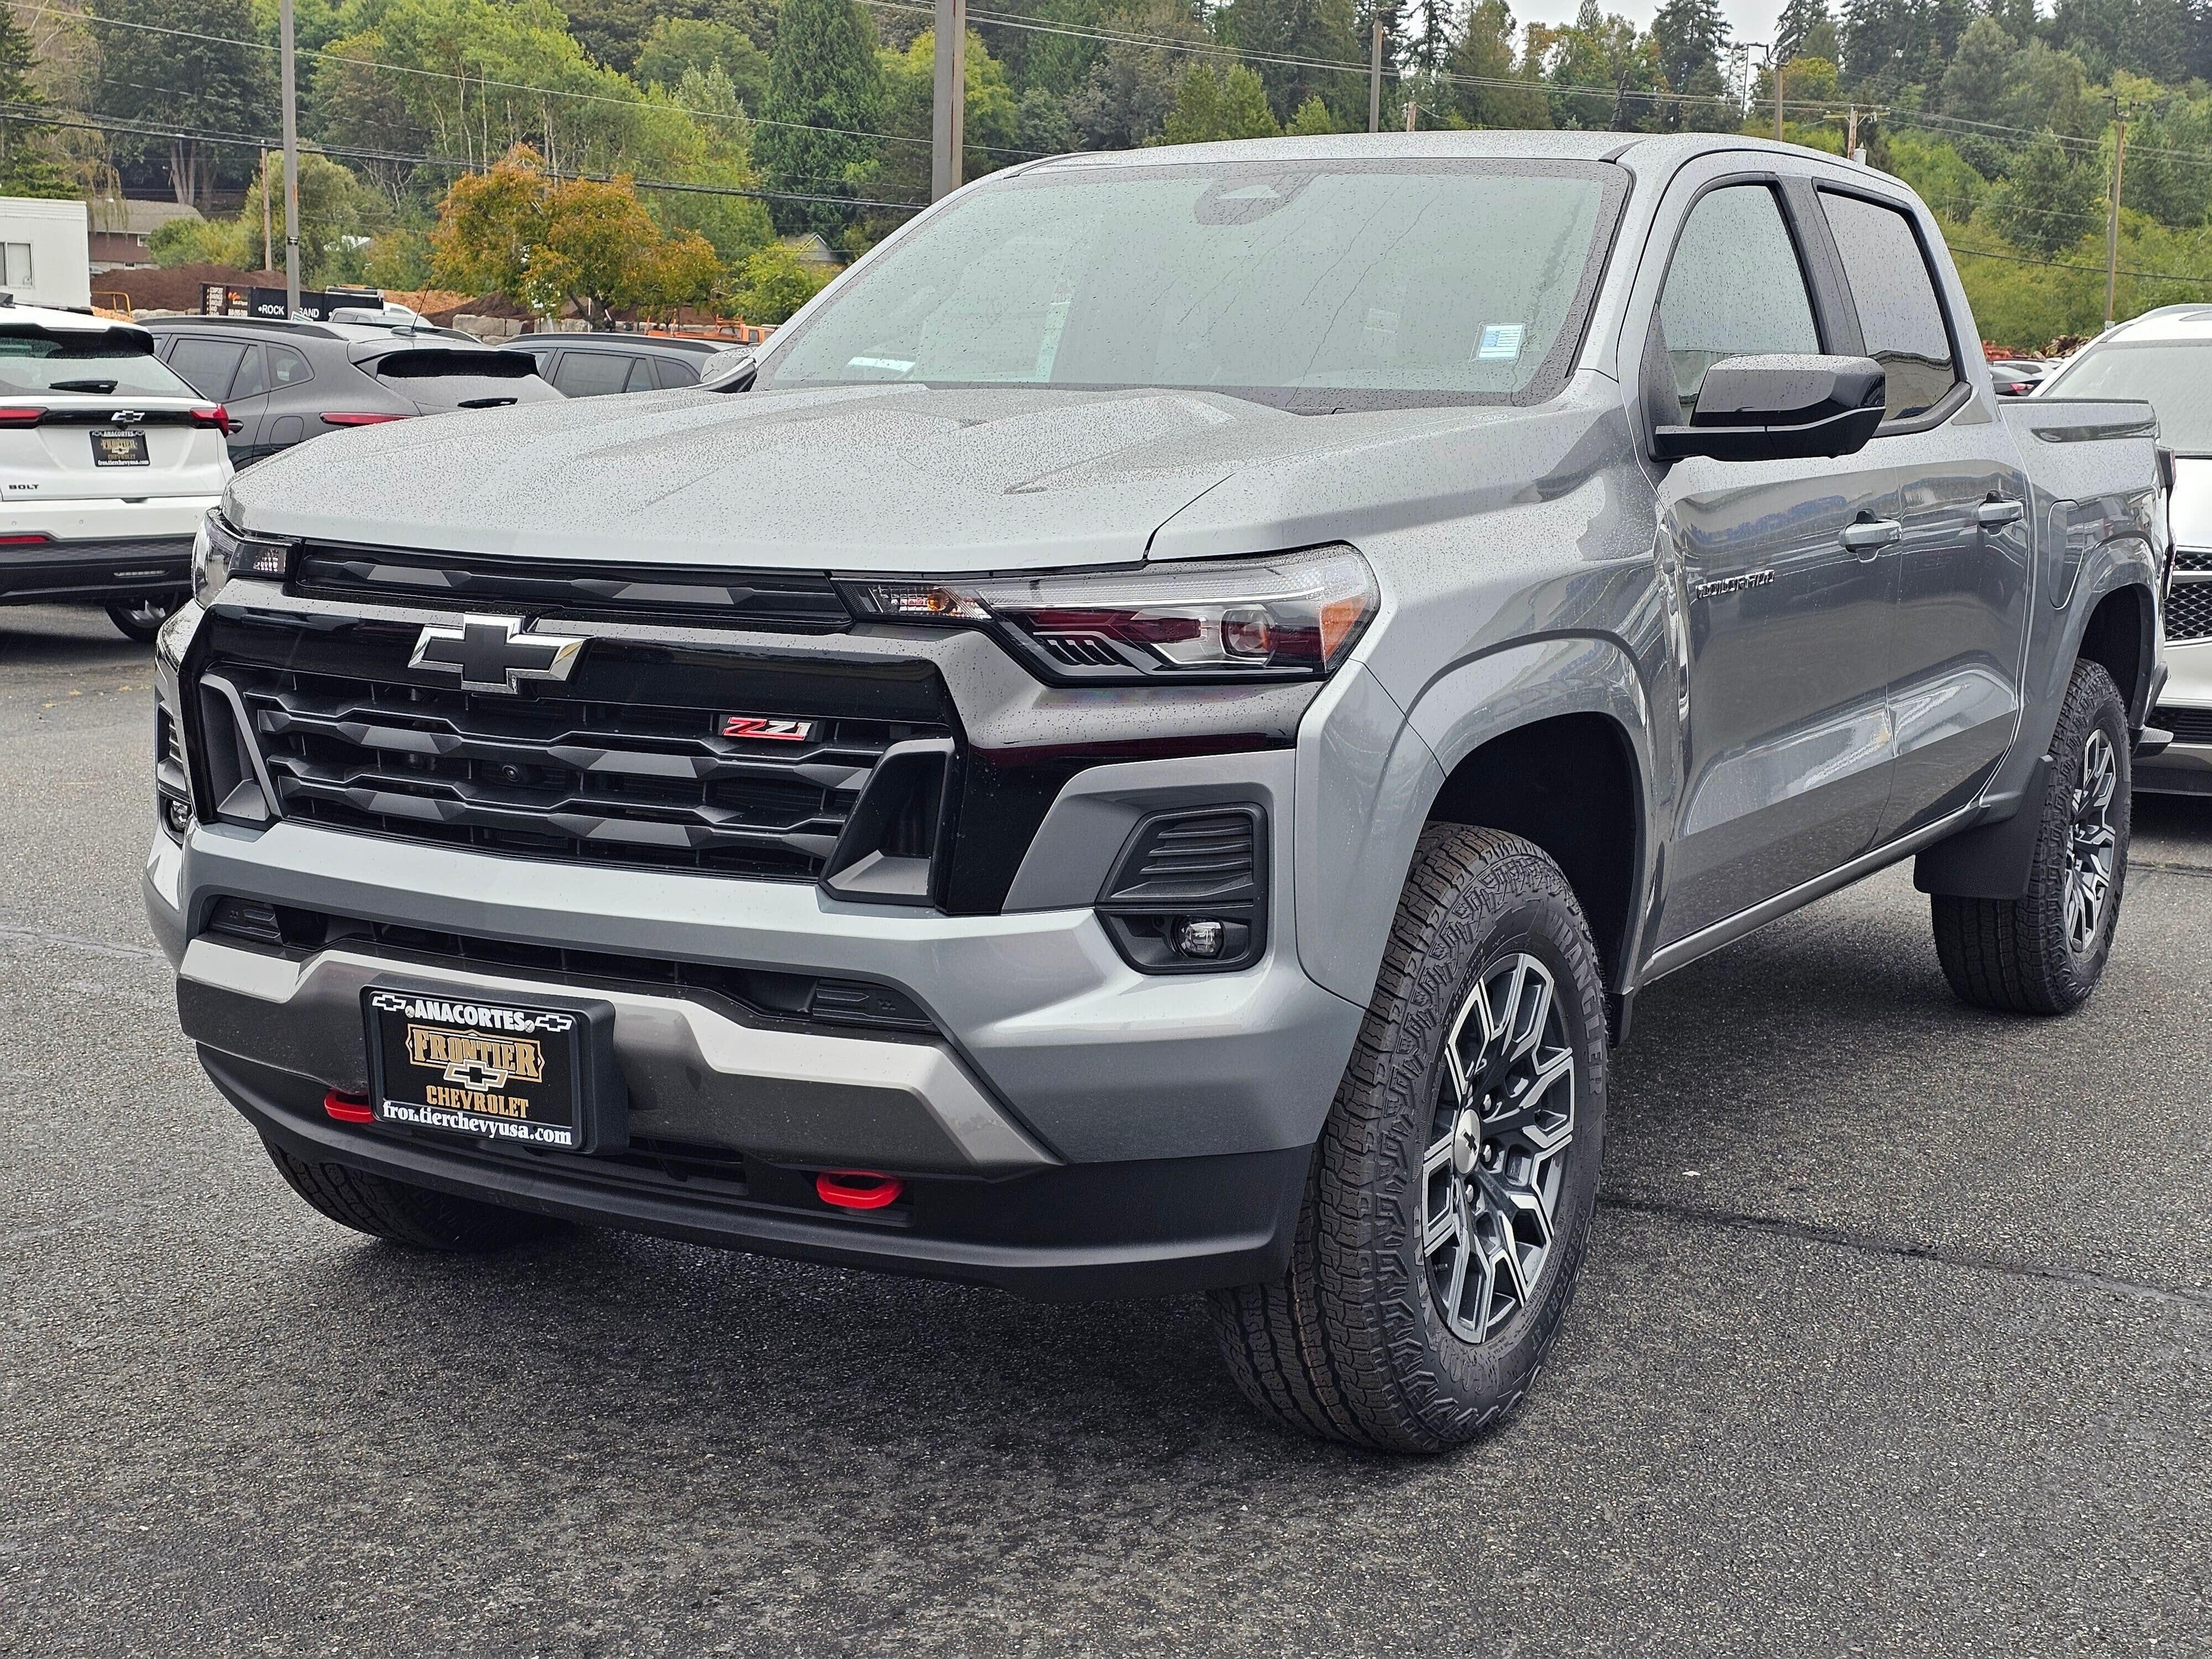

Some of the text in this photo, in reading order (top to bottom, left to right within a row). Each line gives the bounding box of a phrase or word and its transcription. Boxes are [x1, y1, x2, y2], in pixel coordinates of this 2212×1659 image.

[262, 304, 320, 319] ROCK SAND
[1695, 568, 1775, 599] COLORADO
[722, 717, 812, 741] Z71
[414, 999, 525, 1031] ANACORTES
[1545, 912, 1603, 1095] WRANGLER
[412, 1028, 539, 1077] FRONTIER
[425, 1085, 529, 1119] CHEVROLET
[383, 1101, 572, 1145] frontierchevyusa.com
